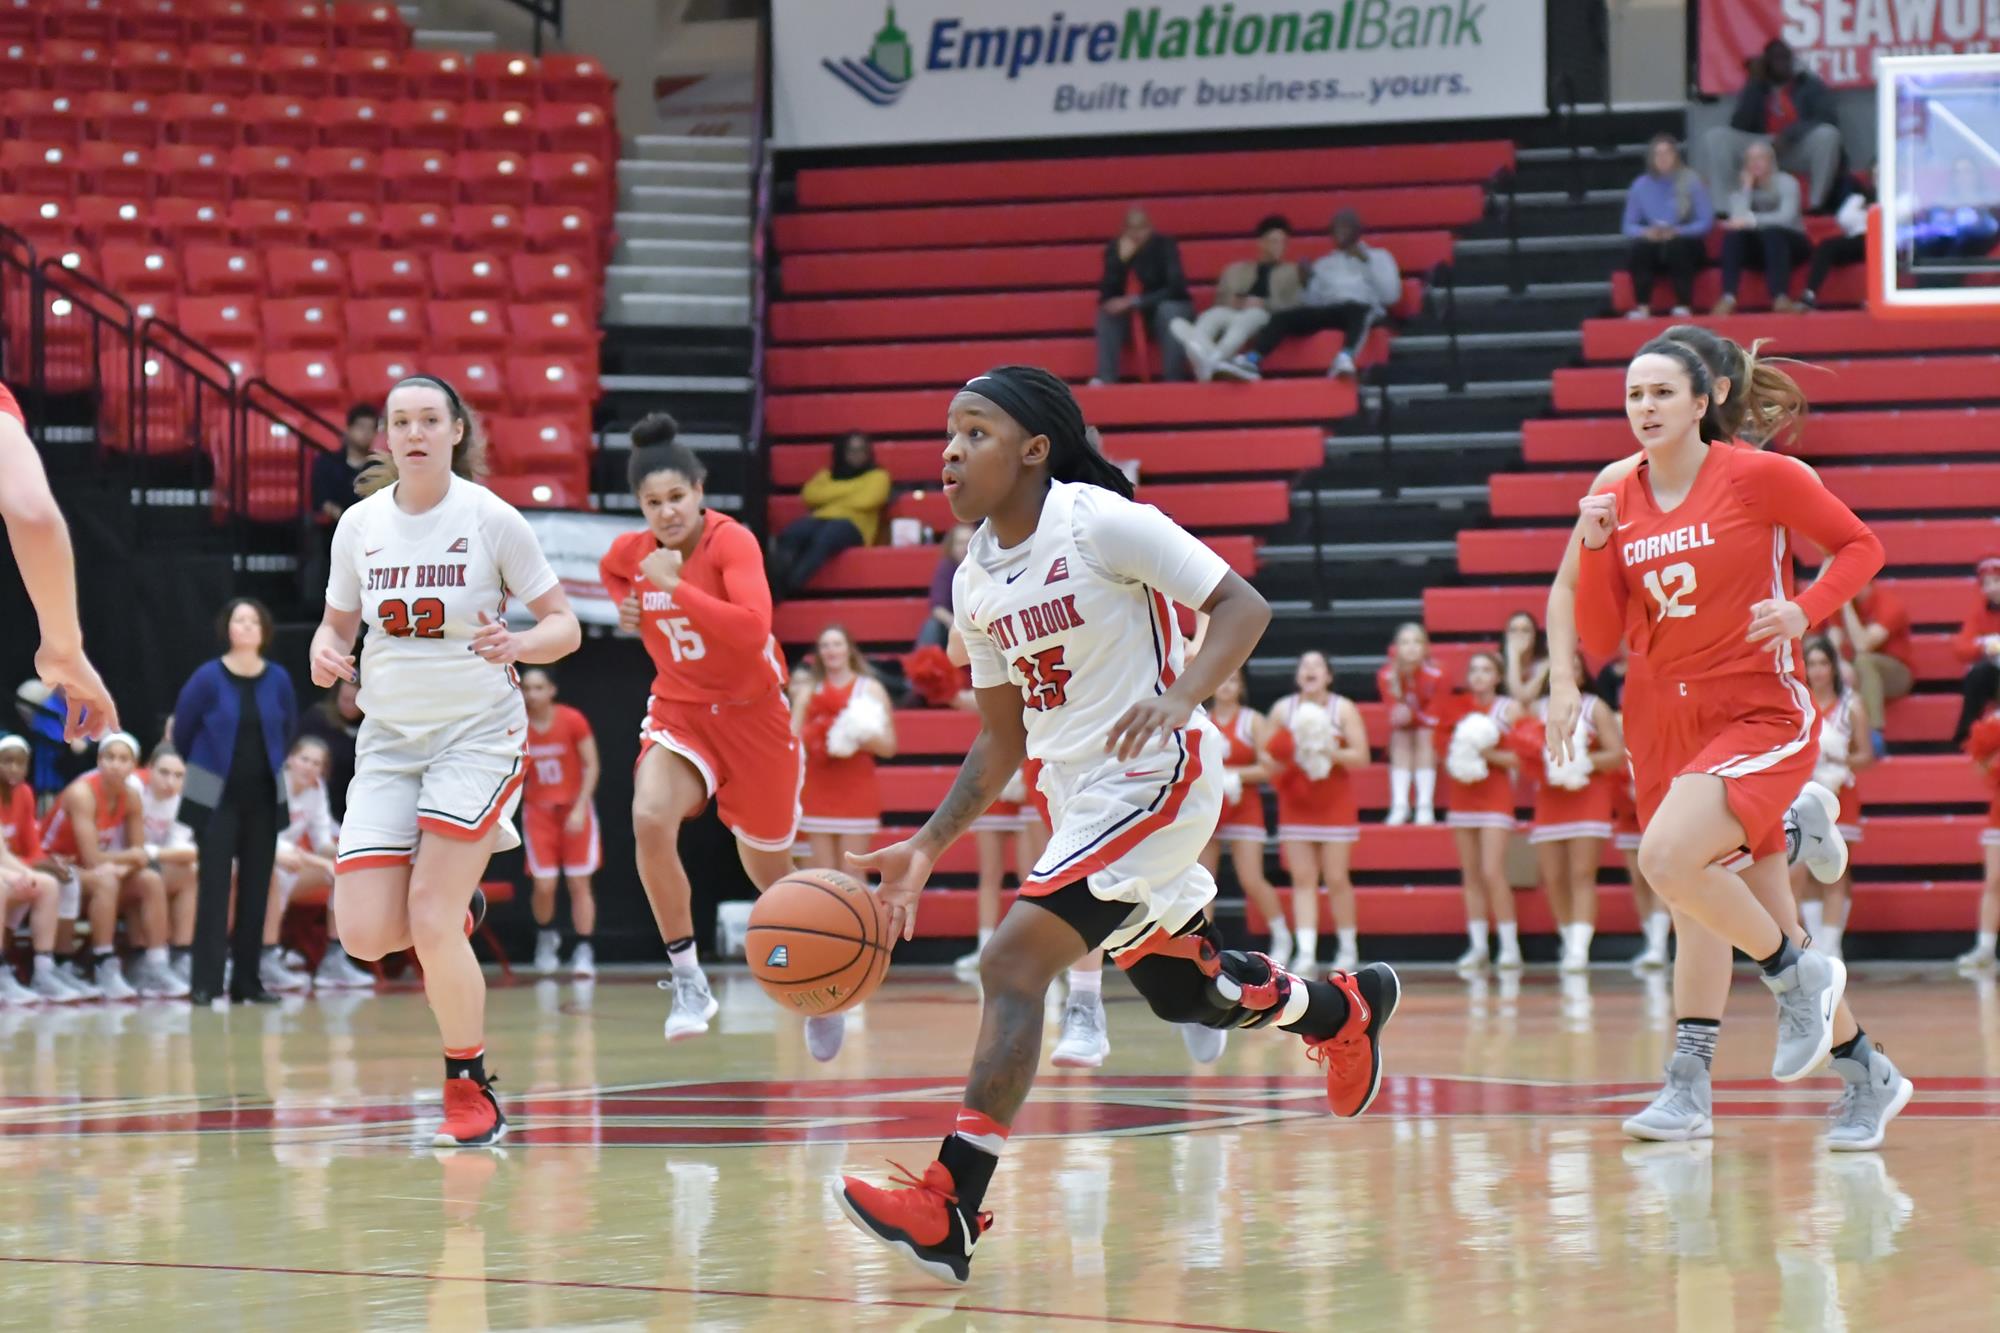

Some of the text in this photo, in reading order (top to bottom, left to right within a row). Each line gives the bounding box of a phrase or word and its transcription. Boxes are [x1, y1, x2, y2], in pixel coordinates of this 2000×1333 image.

[1054, 84, 1129, 113] Built
[1139, 79, 1187, 109] for
[1623, 522, 1716, 568] CORNELL
[367, 563, 467, 591] STONY BROOK
[1642, 561, 1698, 623] 12
[377, 597, 446, 639] 22
[655, 616, 707, 663] 15
[1018, 593, 1086, 643] BROOK
[1012, 644, 1073, 713] 15
